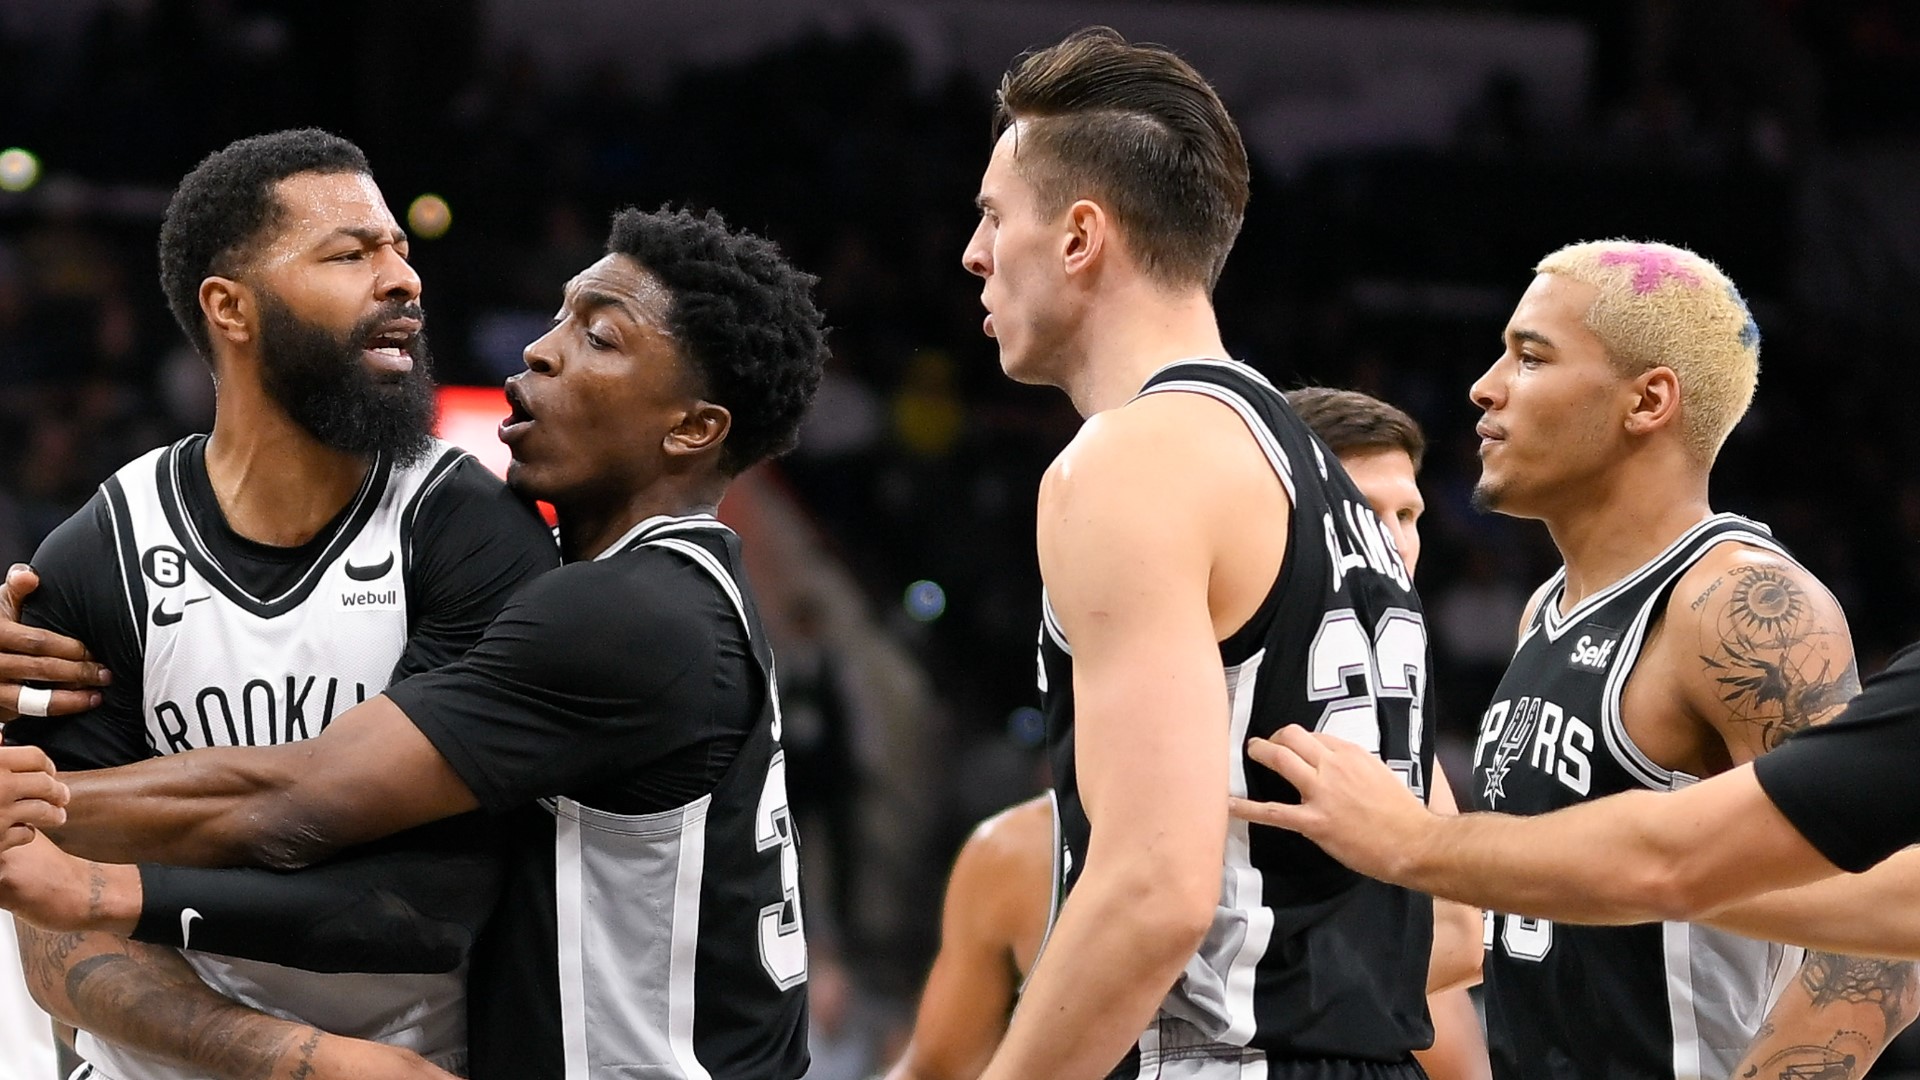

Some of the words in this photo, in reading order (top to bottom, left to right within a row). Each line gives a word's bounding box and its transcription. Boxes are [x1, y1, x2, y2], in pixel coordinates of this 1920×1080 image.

[153, 549, 180, 584] 6
[341, 590, 397, 607] Webull
[1691, 577, 1724, 611] never
[1307, 607, 1428, 808] 23
